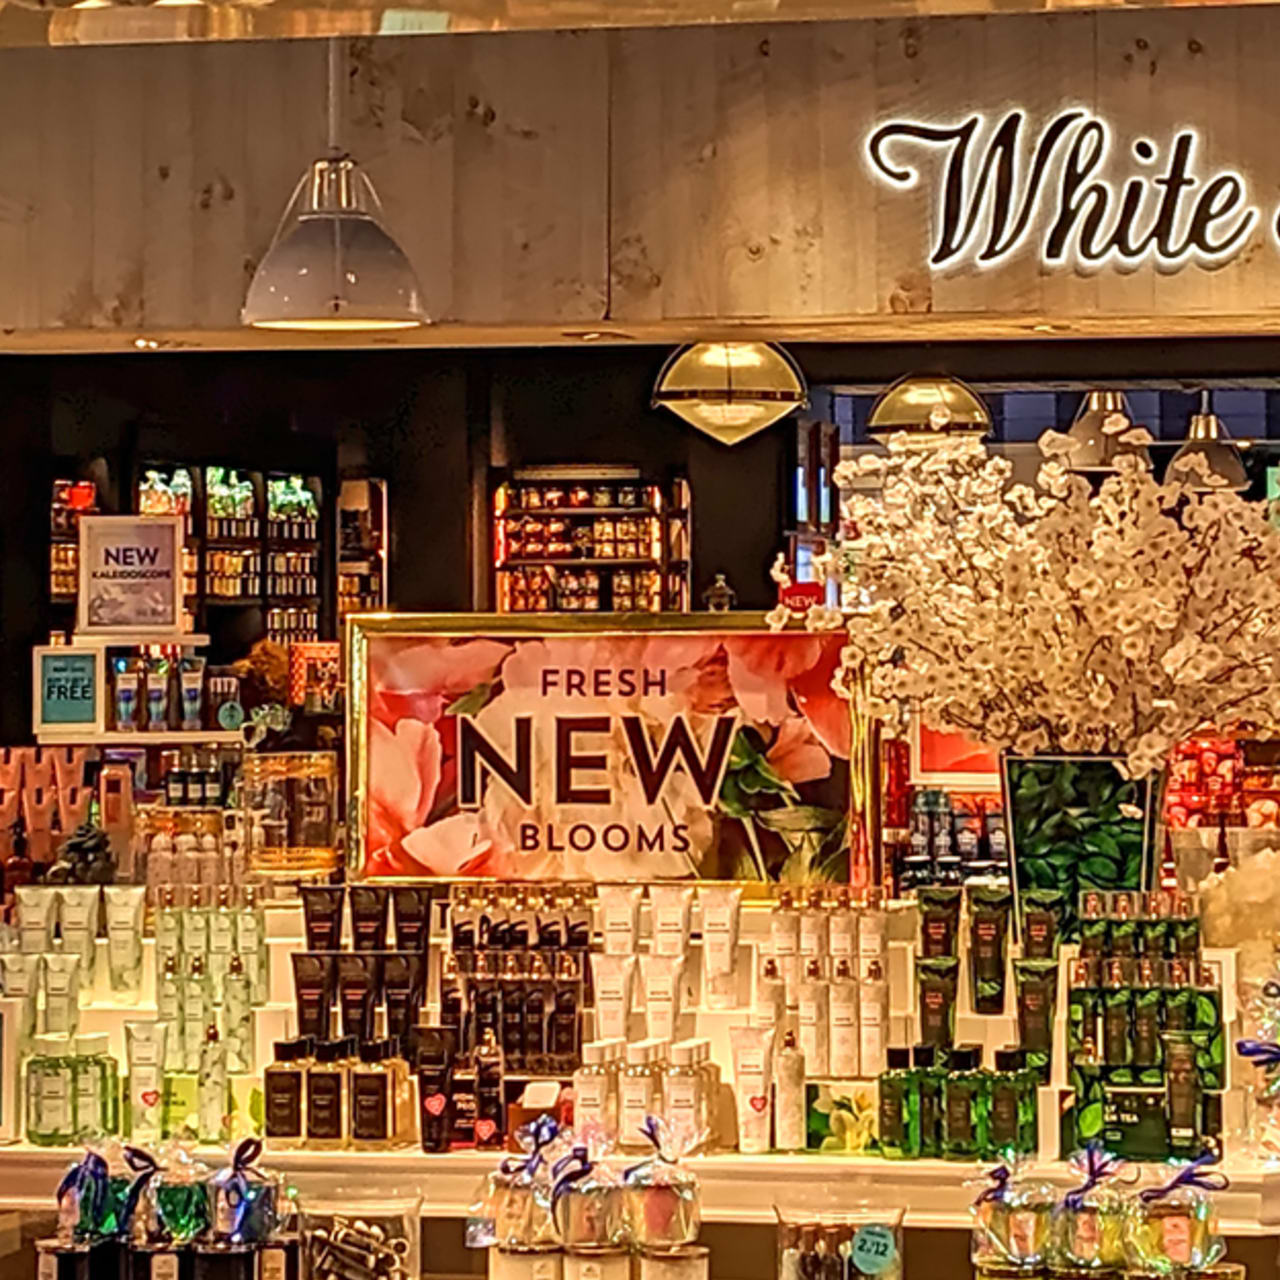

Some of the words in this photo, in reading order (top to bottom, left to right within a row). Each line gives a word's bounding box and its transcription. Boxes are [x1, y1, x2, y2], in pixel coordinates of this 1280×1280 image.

[867, 109, 1256, 265] White
[103, 547, 159, 566] NEW
[784, 595, 818, 607] NEW
[46, 684, 93, 702] FREE
[541, 668, 666, 697] FRESH
[459, 715, 738, 807] NEW
[519, 822, 691, 852] BLOOMS
